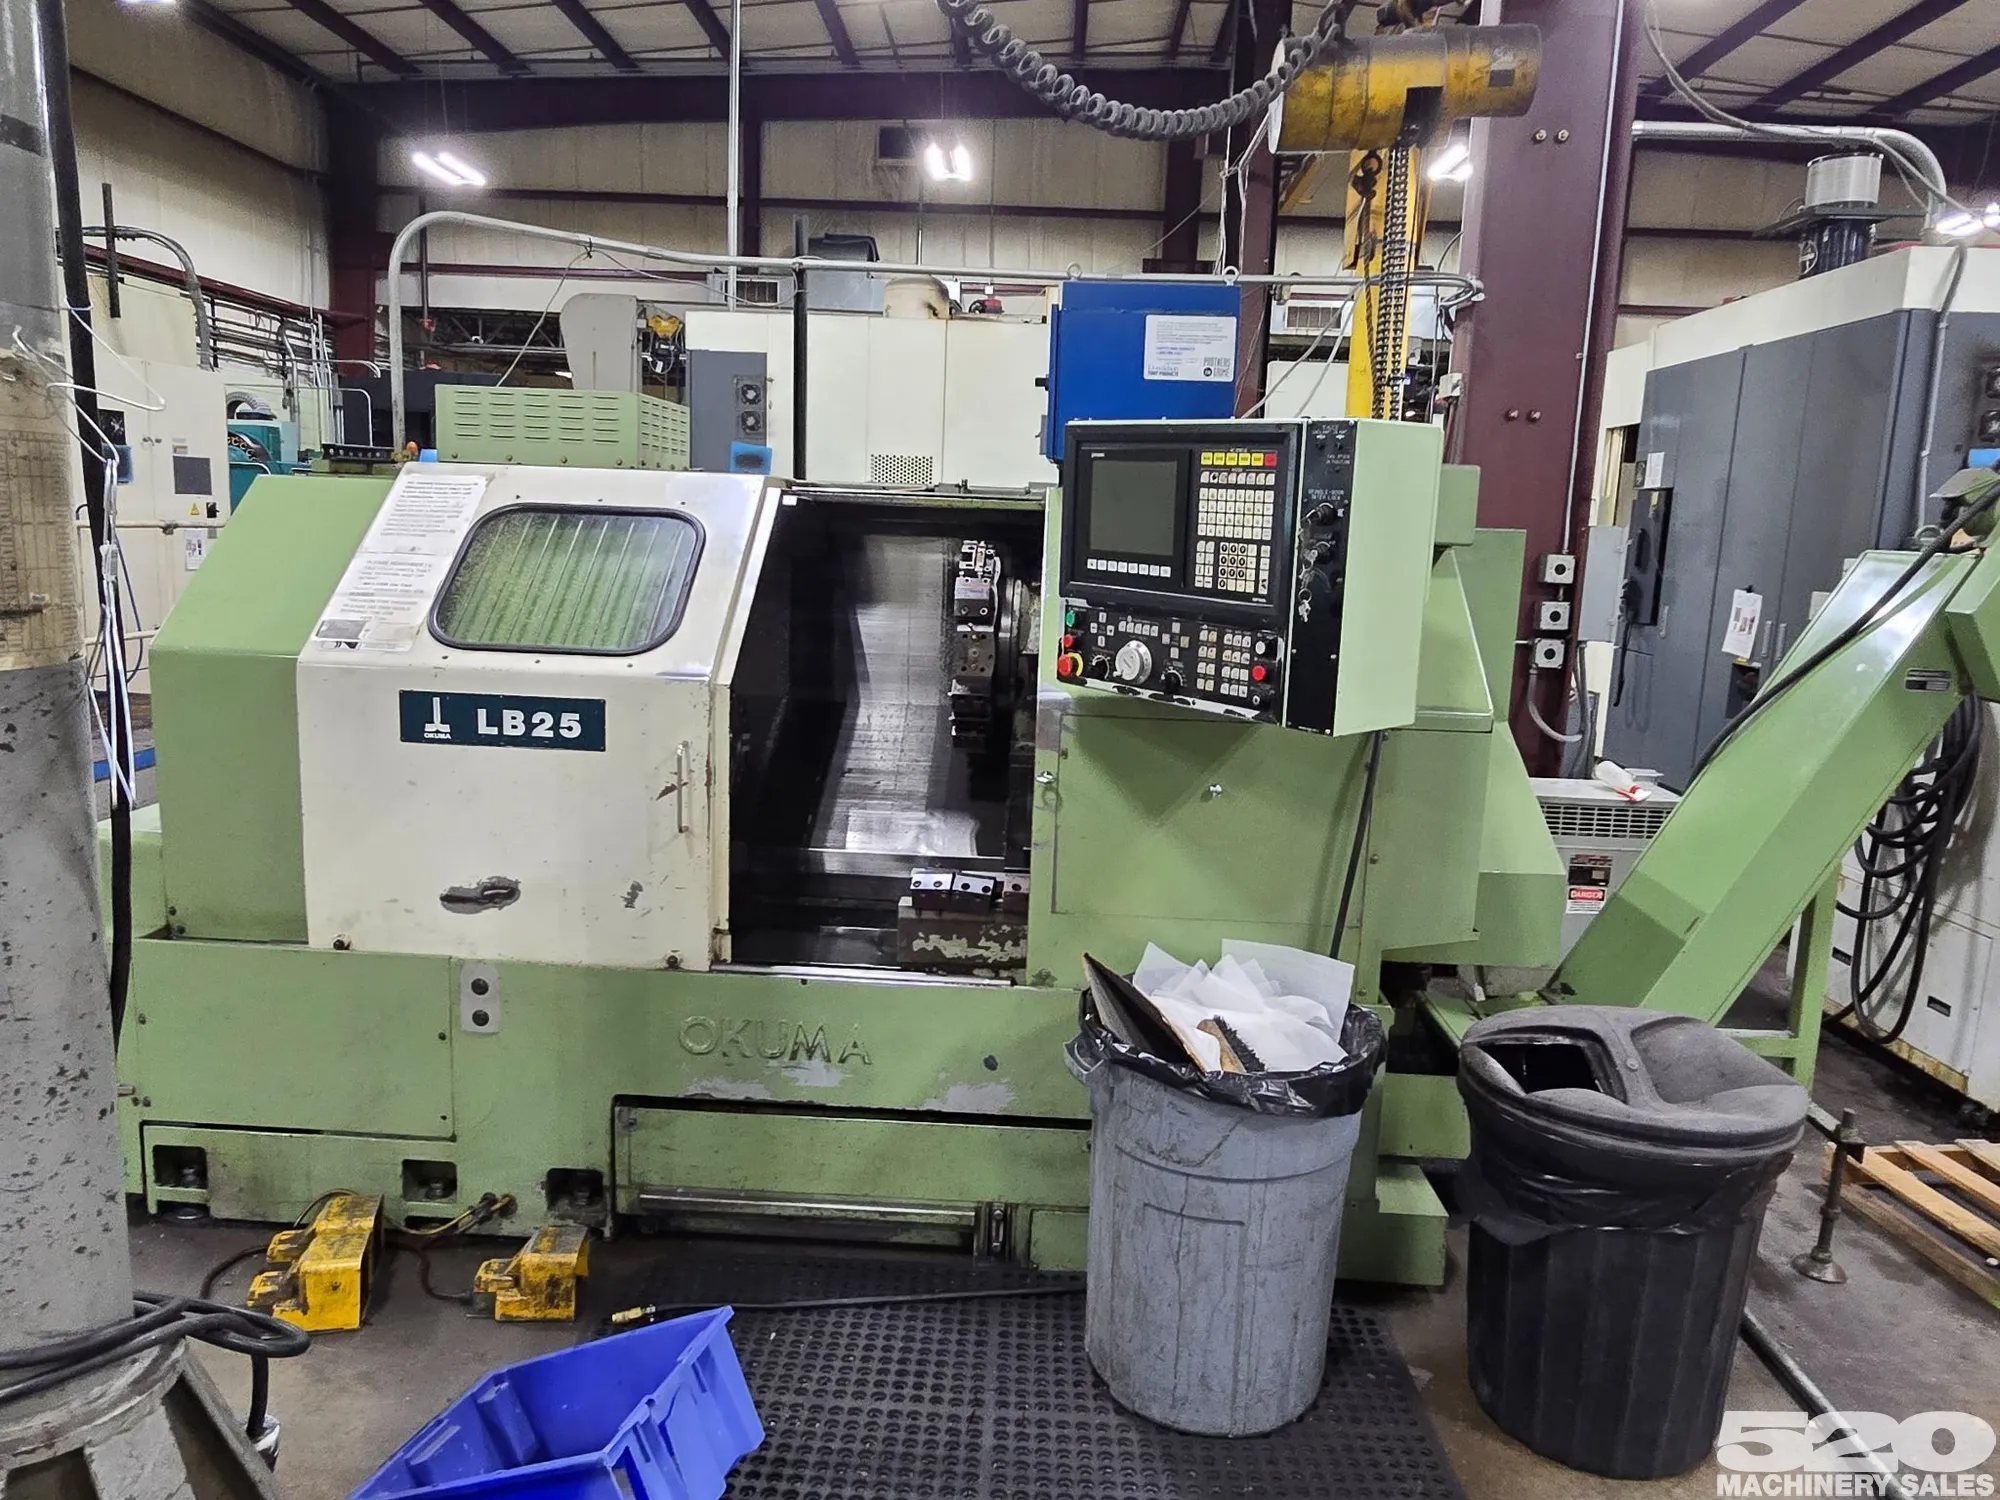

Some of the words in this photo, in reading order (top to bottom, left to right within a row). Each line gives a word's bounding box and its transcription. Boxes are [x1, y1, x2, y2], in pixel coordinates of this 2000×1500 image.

[476, 708, 583, 739] LB25
[423, 732, 452, 740] OKUMA
[1570, 890, 1604, 899] DANGER
[679, 1015, 873, 1066] OKUMA
